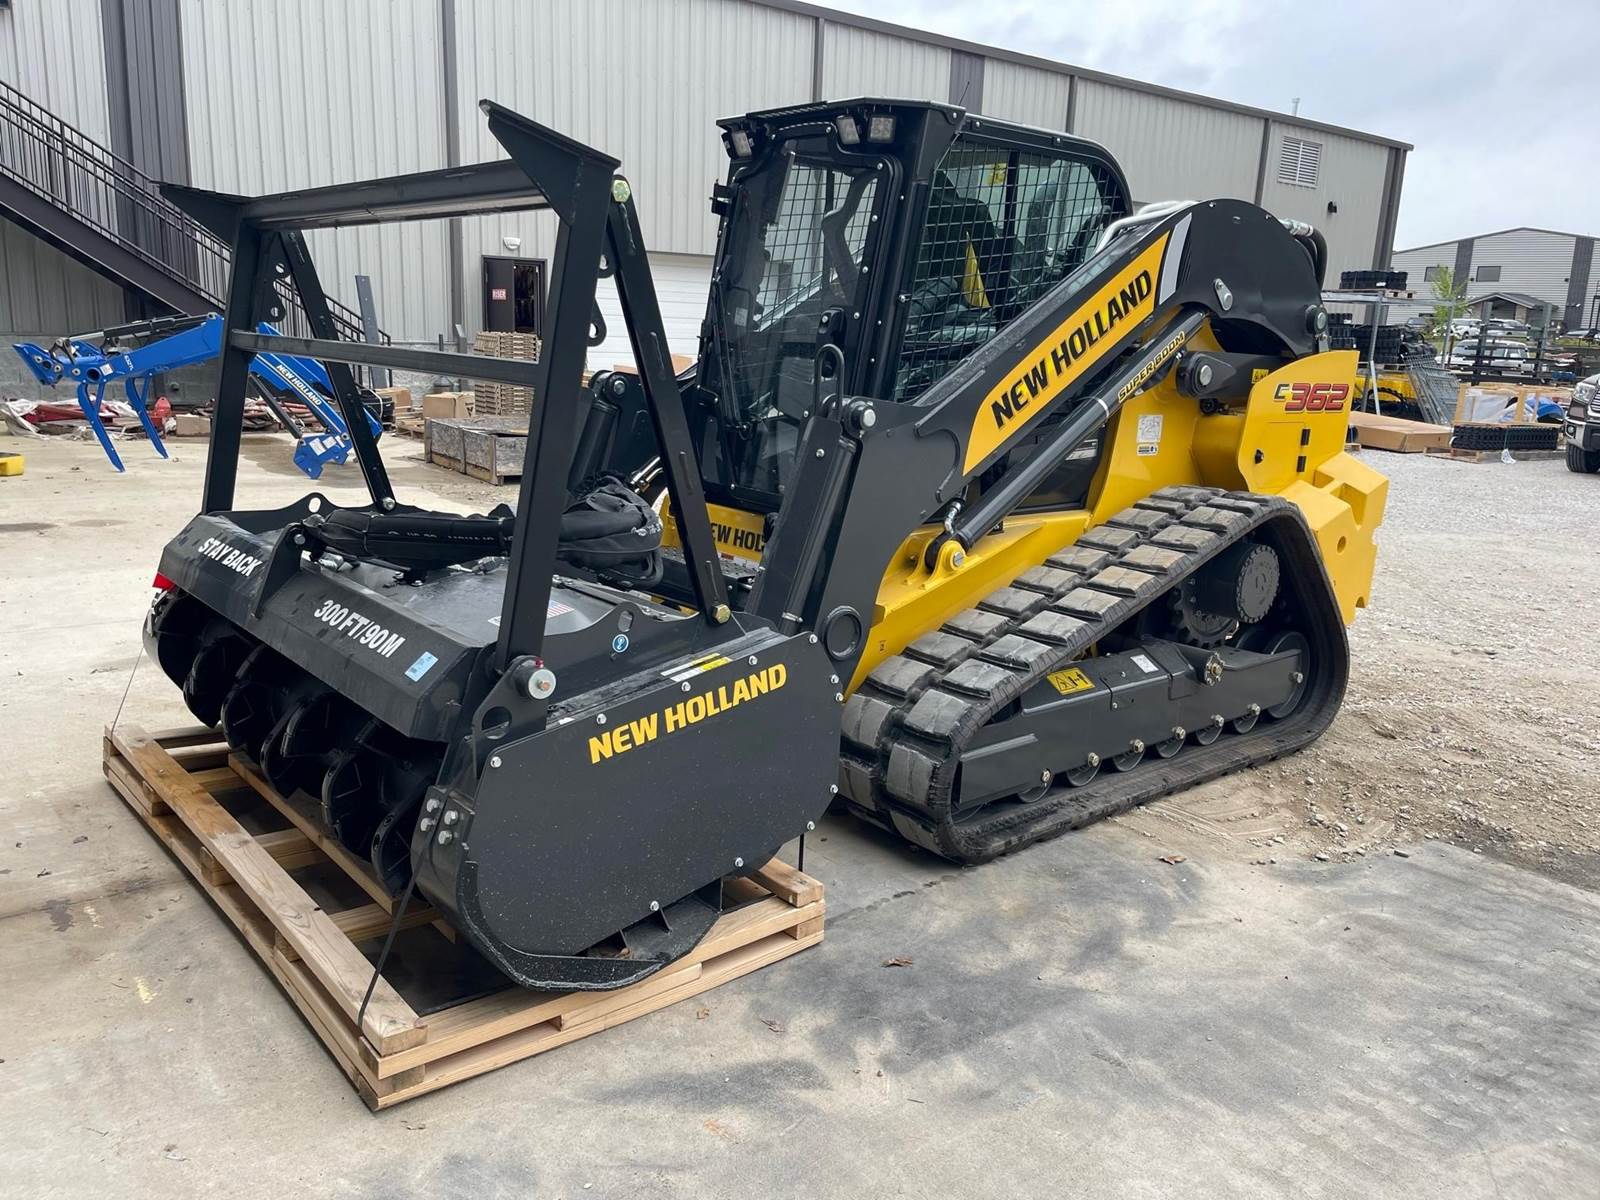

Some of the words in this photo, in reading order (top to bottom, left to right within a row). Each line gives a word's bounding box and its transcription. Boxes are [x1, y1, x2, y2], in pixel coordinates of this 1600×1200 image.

[991, 358, 1048, 429] NEW
[1050, 270, 1152, 376] HOLLAND
[1118, 361, 1155, 402] SUPER
[1154, 331, 1185, 368] BOOM
[276, 364, 295, 379] NEW
[292, 377, 322, 406] HOLLAND
[198, 537, 234, 561] STAY
[221, 549, 263, 577] BACK
[710, 522, 732, 544] EW
[314, 600, 349, 626] 300
[337, 611, 406, 658] FT/90M
[588, 712, 658, 765] NEW
[664, 663, 787, 733] HOLLAND
